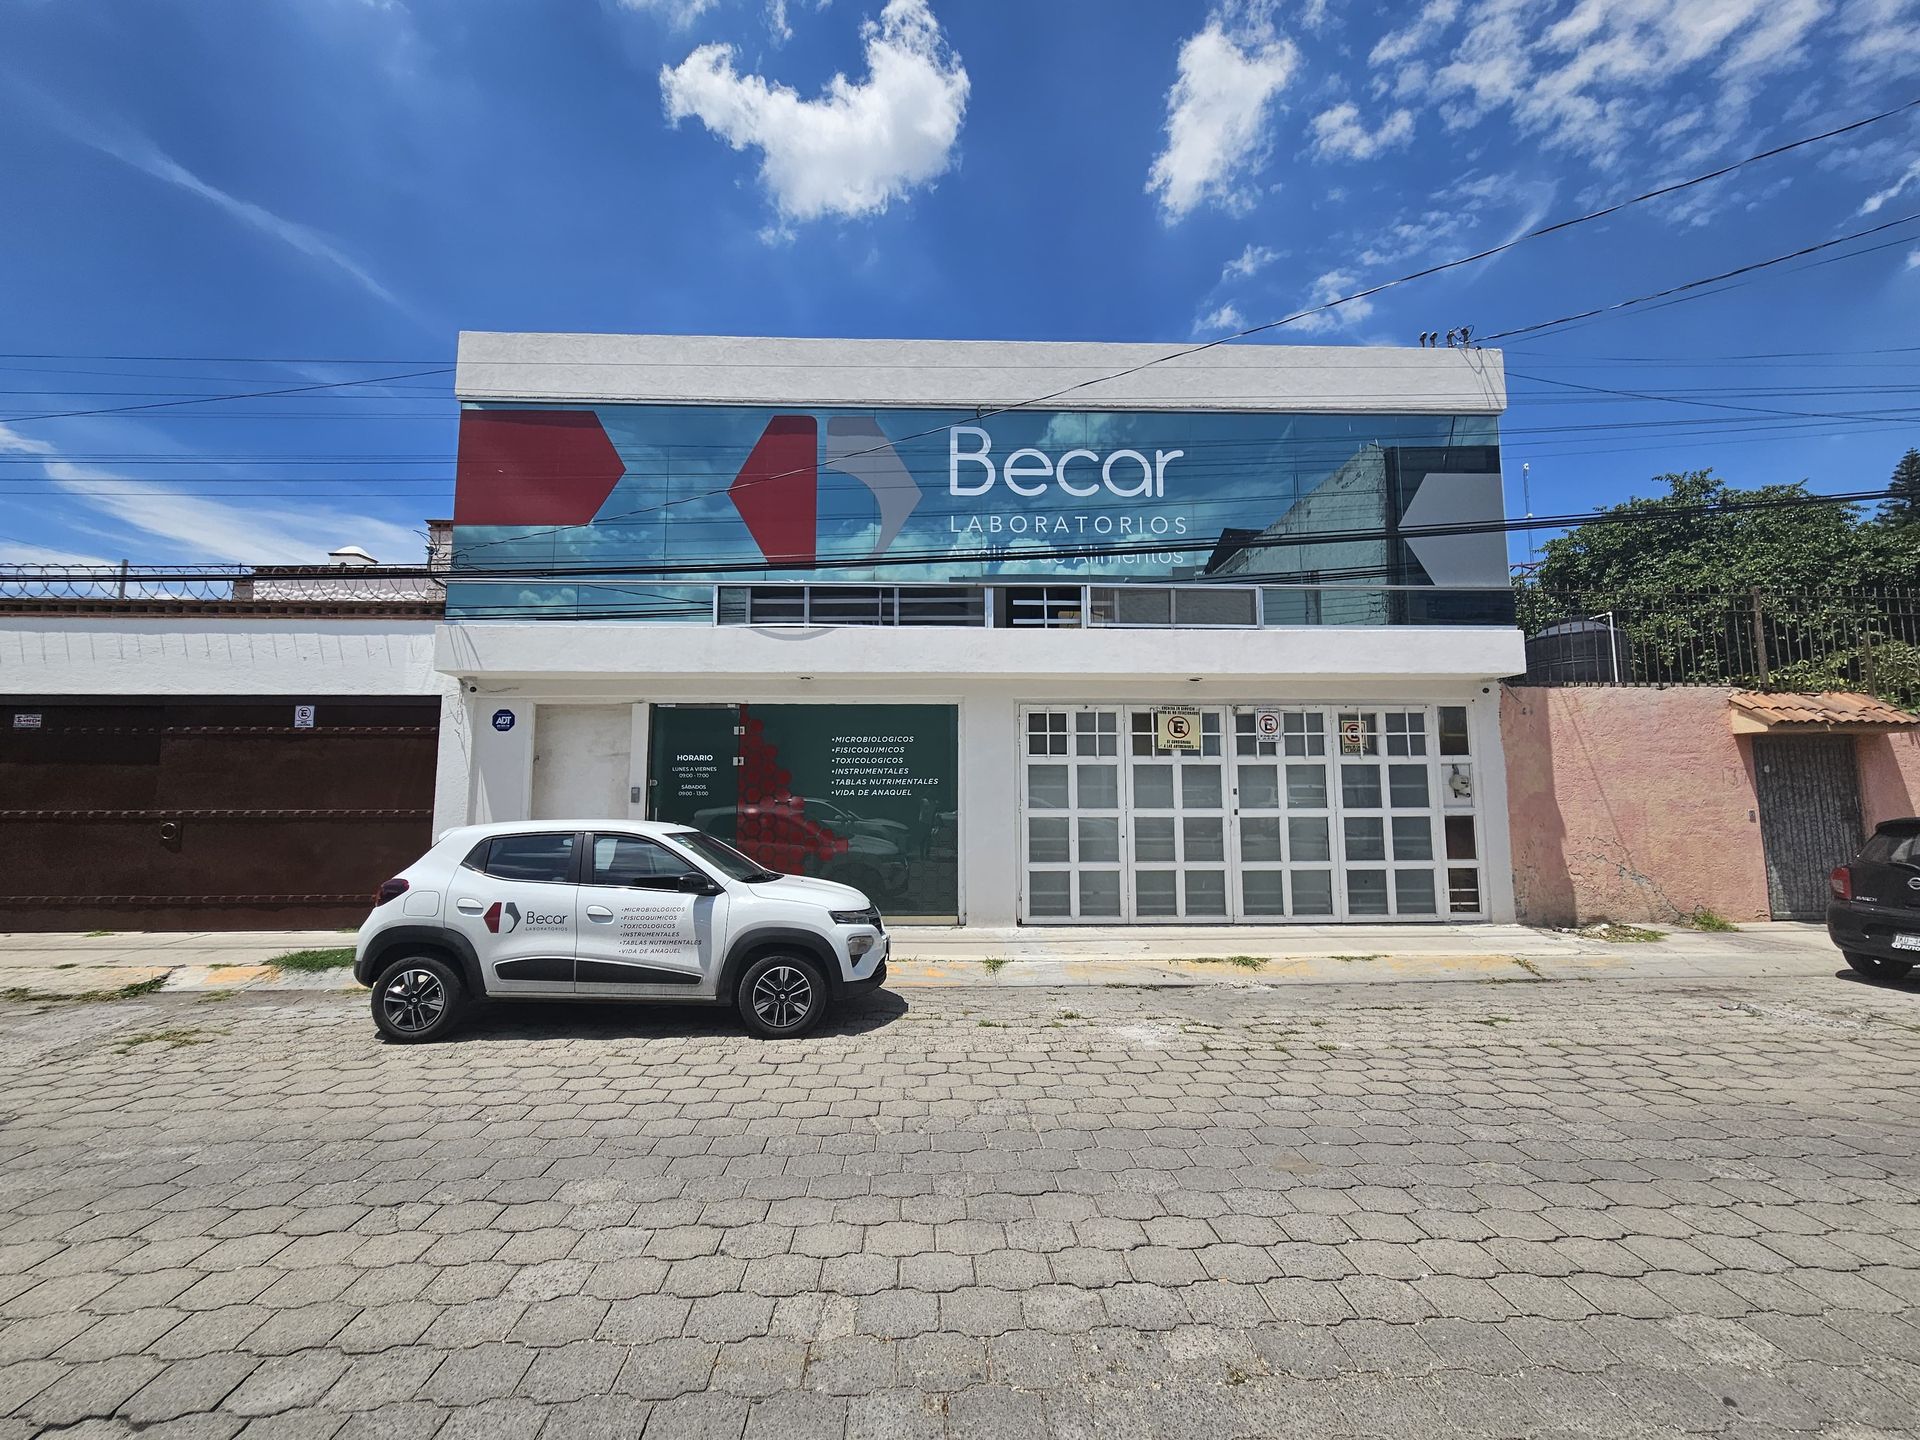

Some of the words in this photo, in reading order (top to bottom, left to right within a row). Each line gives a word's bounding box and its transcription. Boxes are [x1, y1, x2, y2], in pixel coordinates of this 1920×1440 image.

[950, 426, 1184, 498] Becar
[950, 515, 1187, 534] LABORATORIOS
[1072, 544, 1184, 564] Alimentos
[496, 716, 511, 725] ADT
[835, 778, 867, 786] TABLAS
[526, 911, 568, 925] Becar
